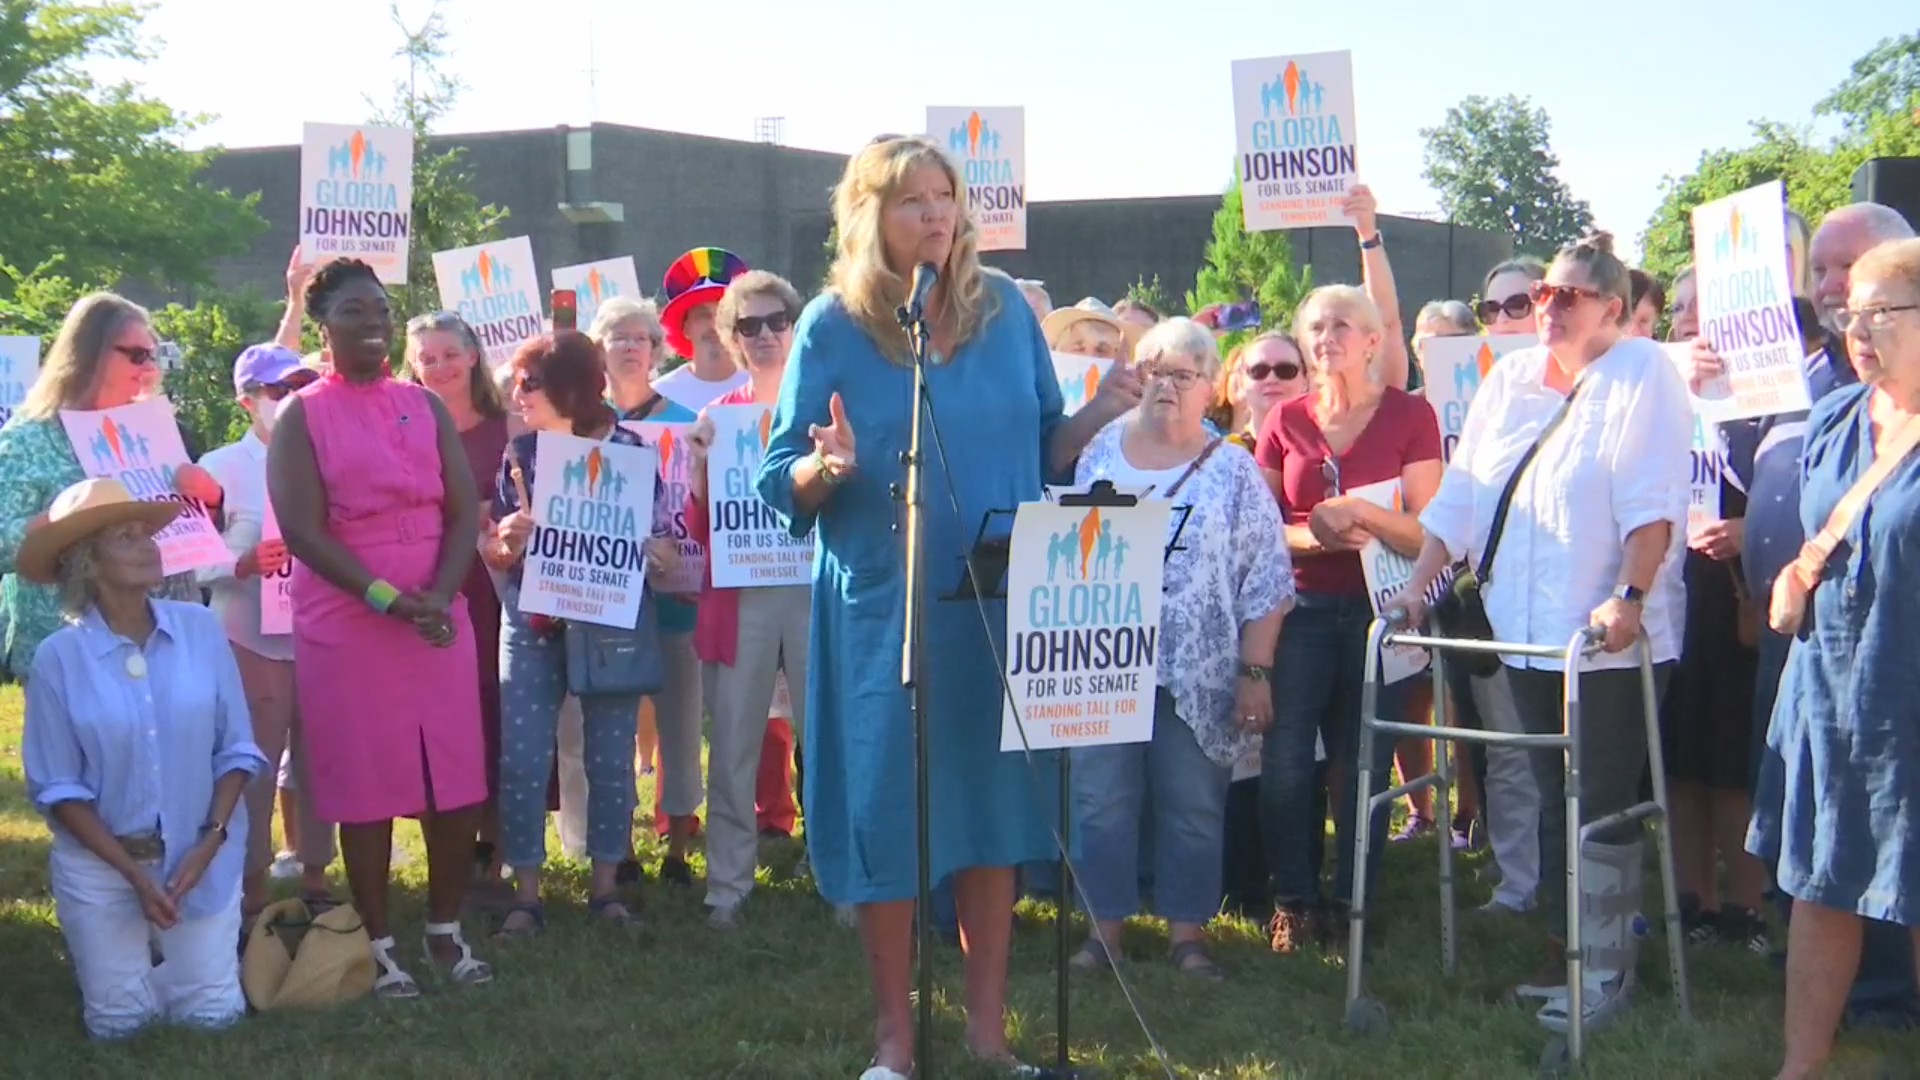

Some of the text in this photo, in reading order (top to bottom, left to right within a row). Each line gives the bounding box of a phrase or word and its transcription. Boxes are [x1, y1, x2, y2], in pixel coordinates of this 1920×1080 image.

[1252, 114, 1342, 150] GLORIA
[965, 159, 1013, 185] ORIA
[1243, 144, 1356, 182] JOHNSON
[316, 179, 397, 209] GLORIA
[968, 185, 1023, 211] NSON
[1257, 179, 1345, 197] FOR US SENATE
[304, 207, 408, 238] JOHNSON
[316, 238, 396, 253] FOR US SENATE
[1707, 265, 1778, 315] GLORIA
[458, 290, 530, 323] GLORIA
[475, 311, 542, 347] HNSON
[1735, 352, 1750, 372] US
[1753, 347, 1791, 370] SENATE
[546, 495, 636, 538] GLORIA
[713, 499, 778, 532] JOHN
[529, 525, 645, 573] JOHNSON
[727, 533, 751, 549] FOR
[756, 533, 773, 548] US
[728, 552, 774, 565] STANDING
[777, 551, 796, 563] TALL
[750, 566, 798, 579] TENNESSEE
[538, 580, 583, 598] STANDING
[540, 560, 631, 590] FOR US SENATE
[1028, 582, 1142, 629] GLORIA
[1010, 626, 1156, 676] JOHNSON
[1026, 673, 1139, 699] FOR US SENATE
[1025, 698, 1137, 721] STANDING TALL FOR
[1050, 720, 1110, 738] TENNESSEE
